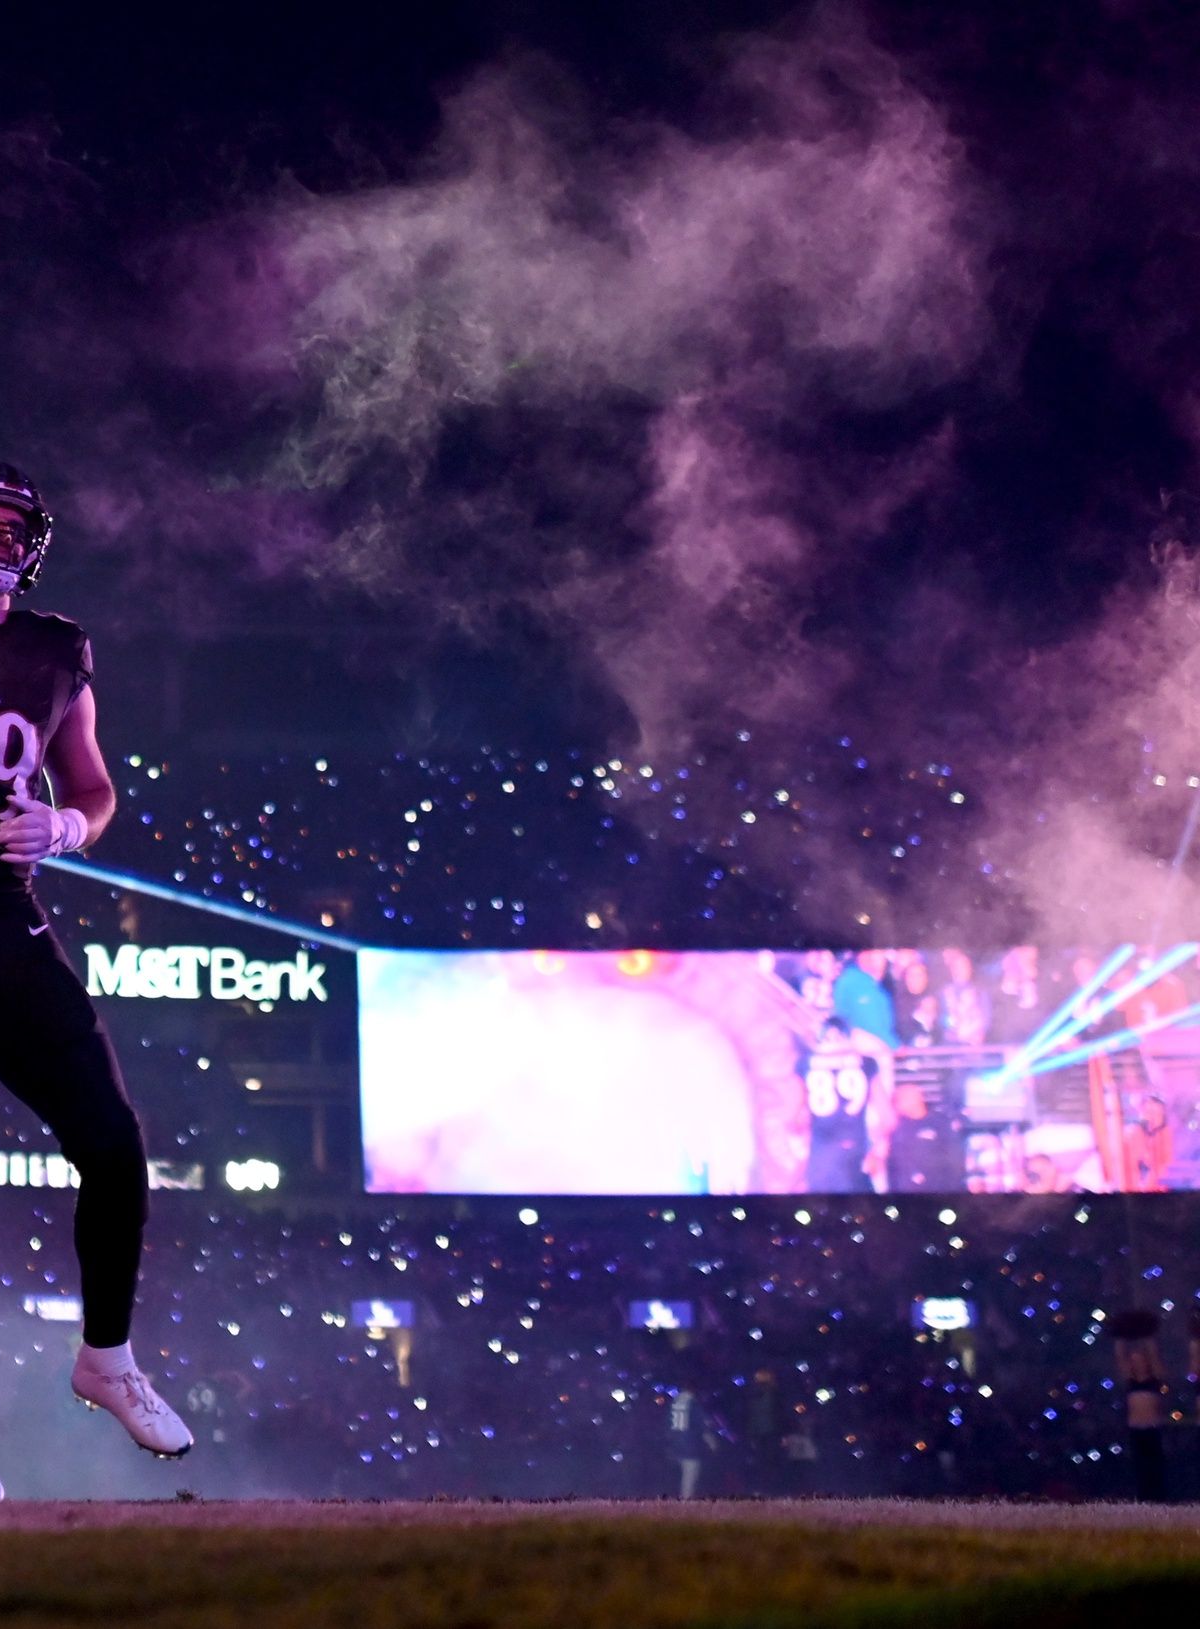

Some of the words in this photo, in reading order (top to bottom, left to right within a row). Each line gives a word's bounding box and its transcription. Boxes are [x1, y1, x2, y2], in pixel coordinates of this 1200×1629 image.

[83, 943, 211, 999] M&T
[209, 946, 328, 1002] Bank
[805, 1068, 869, 1117] 89
